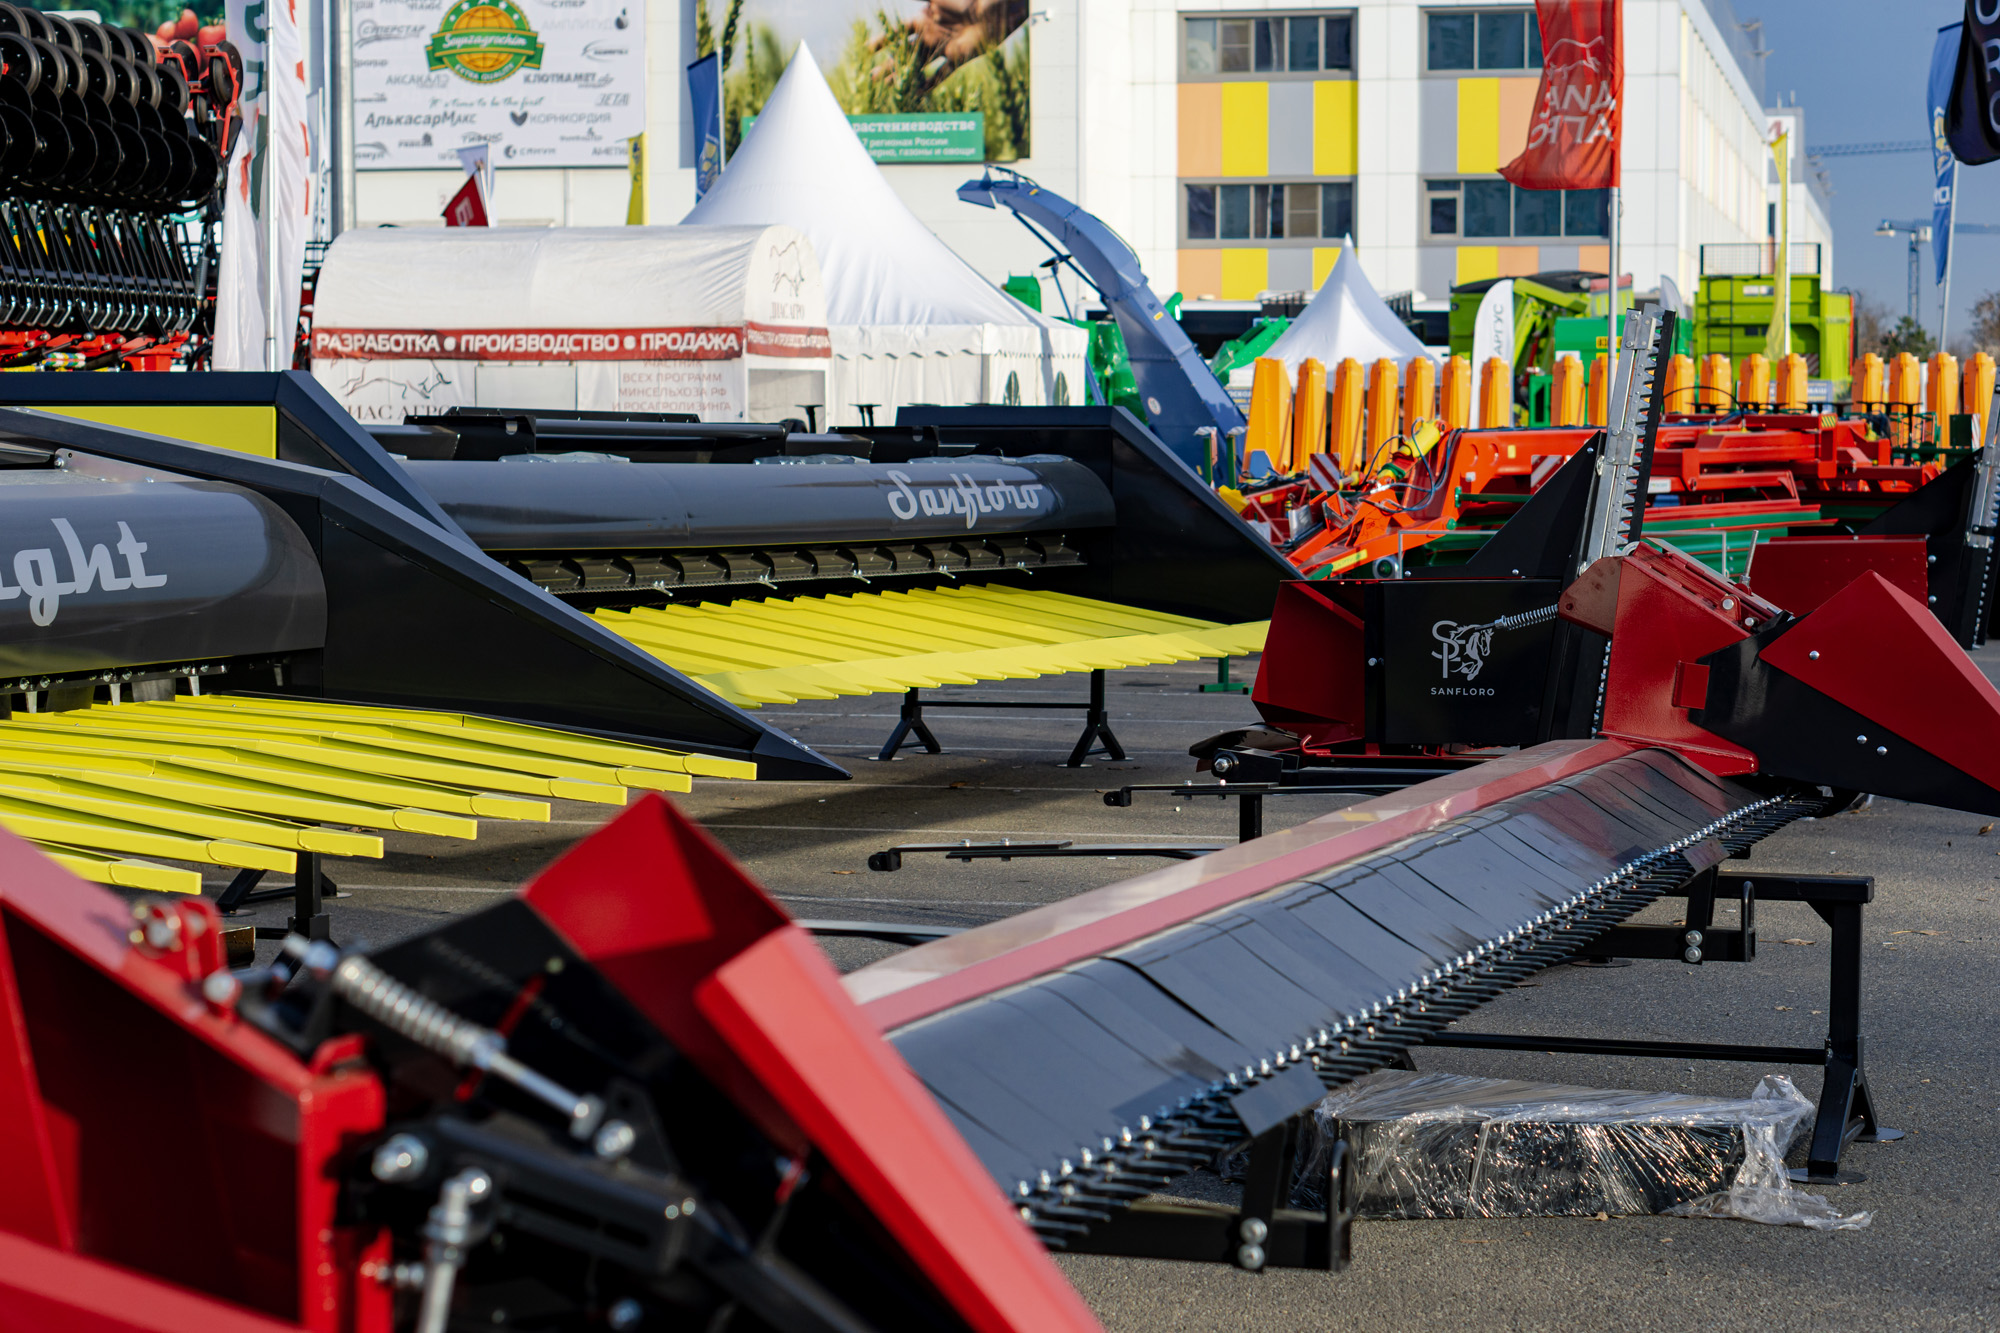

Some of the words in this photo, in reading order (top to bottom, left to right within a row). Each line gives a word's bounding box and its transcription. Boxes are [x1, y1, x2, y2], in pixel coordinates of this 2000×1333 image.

[852, 120, 976, 133] растениеводстве
[316, 333, 441, 352] РАЗРАБОТКА
[460, 333, 620, 354] ПРОИЗВОДСТВО
[640, 333, 740, 352] ПРОДАЖА
[623, 373, 652, 383] ВСЕХ
[656, 372, 722, 383] ПРОГРАММ
[618, 387, 707, 397] МИНСЕЛЬХОЗА
[711, 387, 727, 397] РФ
[344, 404, 393, 420] ИАС
[624, 400, 731, 412] РОСАГРОЛИЗИНГА
[886, 469, 1043, 530] Sanfloro
[1430, 687, 1495, 696] SANFLORO
